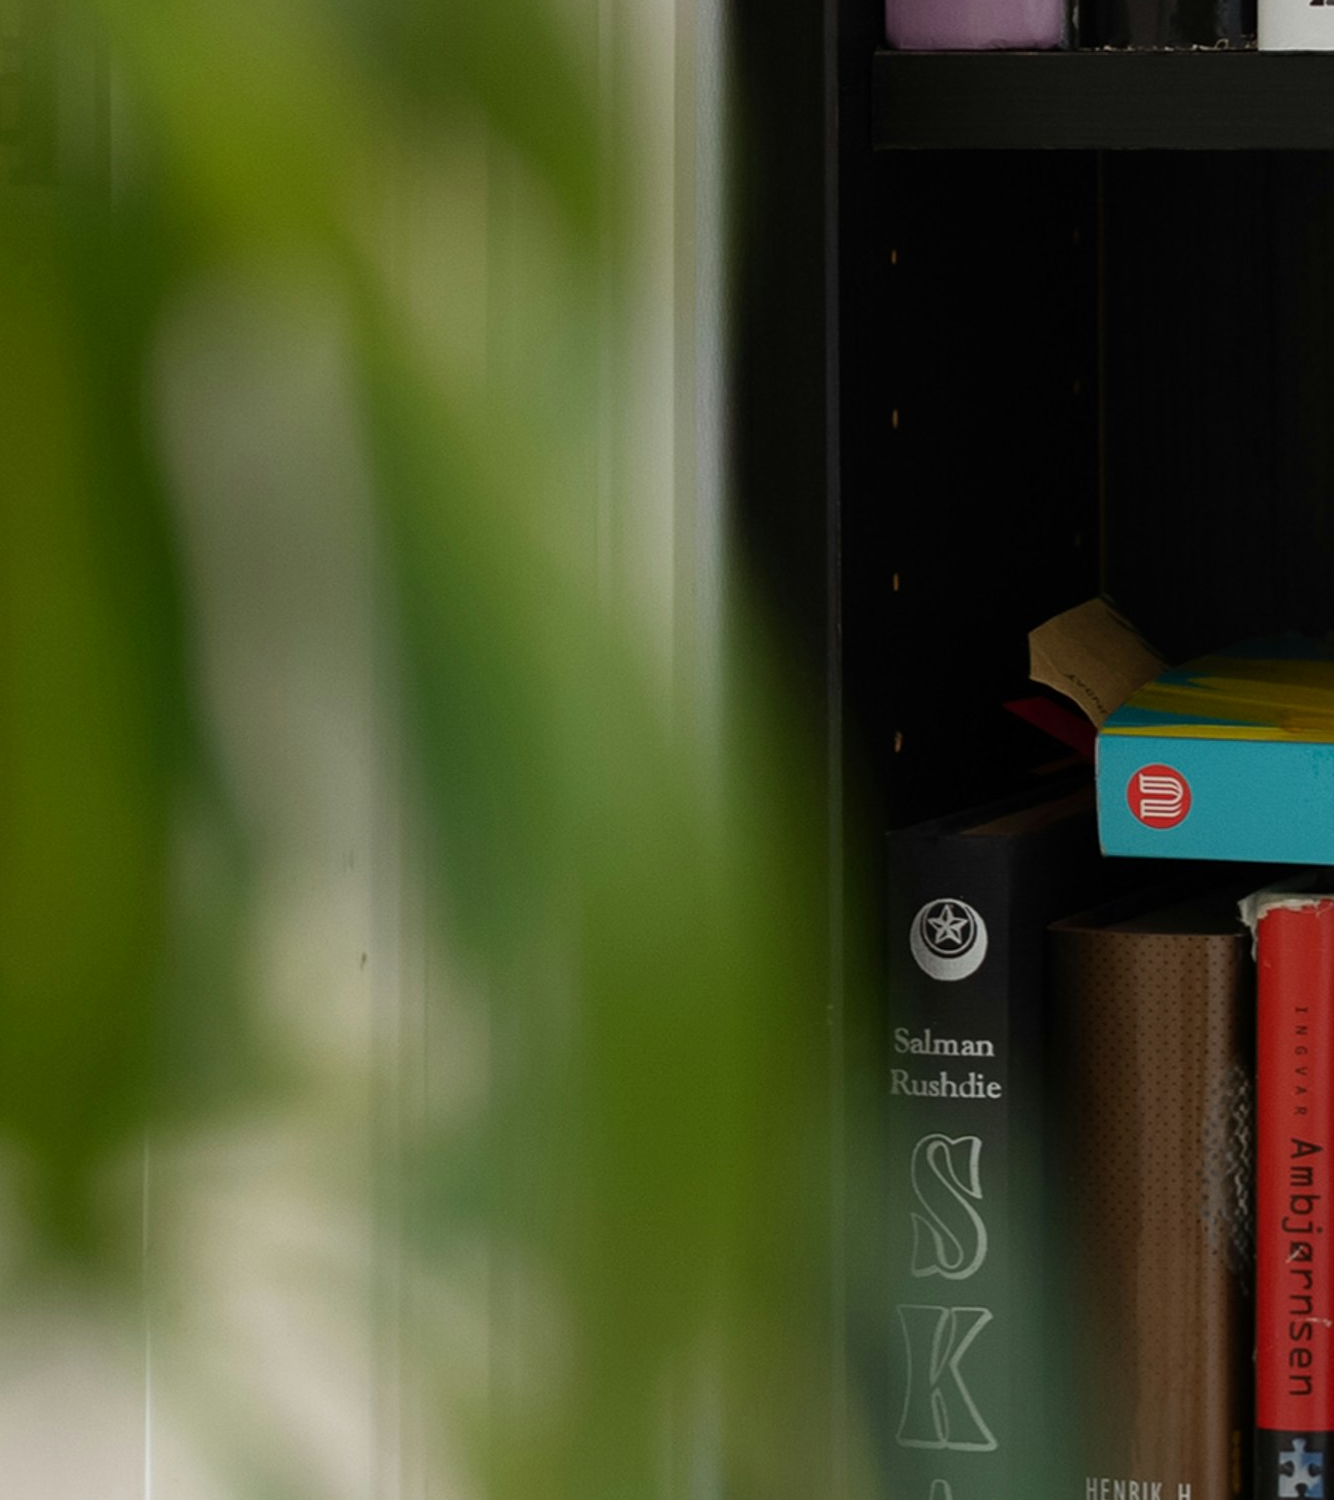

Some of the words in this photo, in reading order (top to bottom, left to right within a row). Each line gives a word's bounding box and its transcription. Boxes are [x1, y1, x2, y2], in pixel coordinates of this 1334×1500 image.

[892, 1027, 995, 1058] Salman
[1294, 1005, 1308, 1115] INGVAR
[889, 1068, 1002, 1100] Rushdie
[1281, 1138, 1324, 1397] Ambjørnsen
